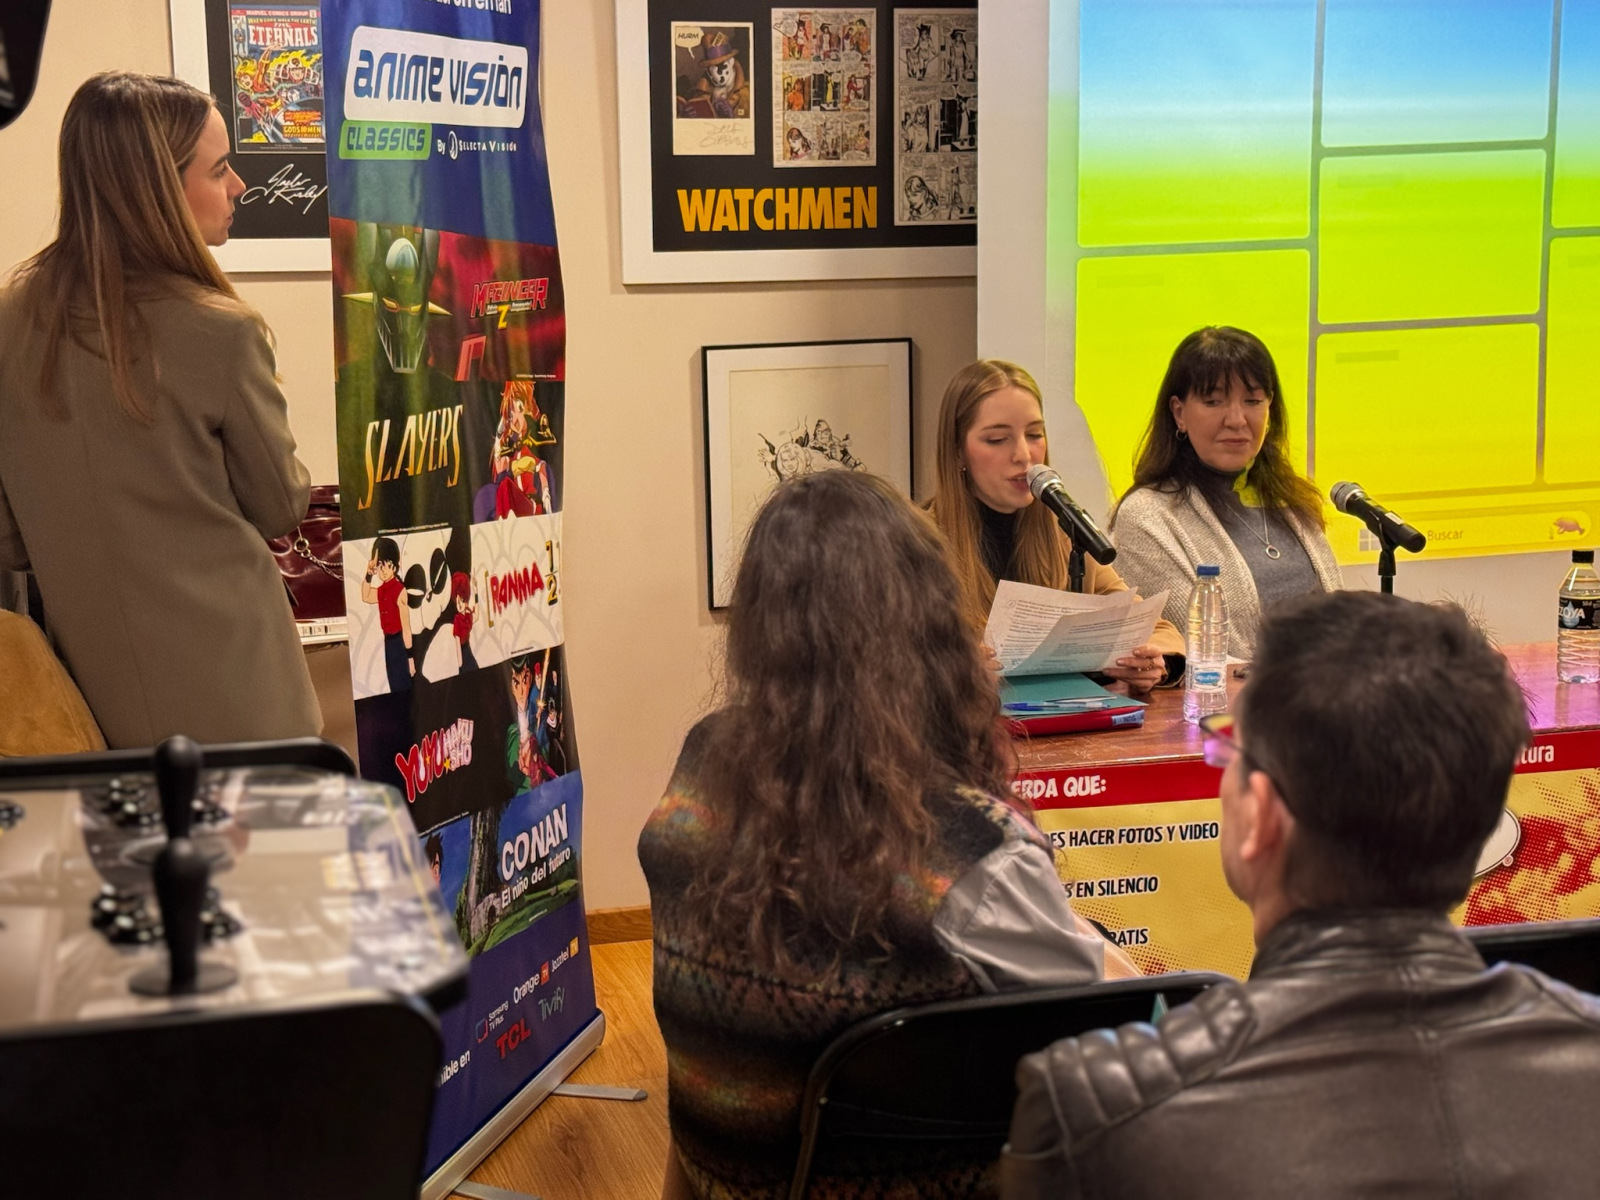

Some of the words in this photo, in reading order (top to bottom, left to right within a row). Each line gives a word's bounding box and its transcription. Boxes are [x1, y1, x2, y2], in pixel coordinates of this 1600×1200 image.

[249, 25, 318, 47] ETERNALS
[677, 186, 878, 232] WATCHMEN
[498, 304, 509, 330] Z
[357, 404, 463, 510] SLAYERS
[1427, 530, 1463, 541] Buscar
[490, 562, 544, 615] RANMA
[1063, 774, 1107, 798] QUE:
[501, 803, 568, 881] CONAN
[1069, 829, 1115, 847] HACER
[1118, 826, 1163, 844] FOTOS
[1167, 825, 1176, 842] Y
[1179, 822, 1219, 841] VIDEO
[501, 887, 511, 909] El
[512, 877, 529, 901] niño
[531, 862, 547, 885] del
[548, 847, 571, 875] futuro
[1076, 881, 1095, 898] EN
[1098, 876, 1159, 897] SILENCIO
[513, 972, 540, 1004] Orange
[489, 1000, 509, 1021] Samsung
[496, 1018, 531, 1059] TCL
[460, 1050, 470, 1068] en
